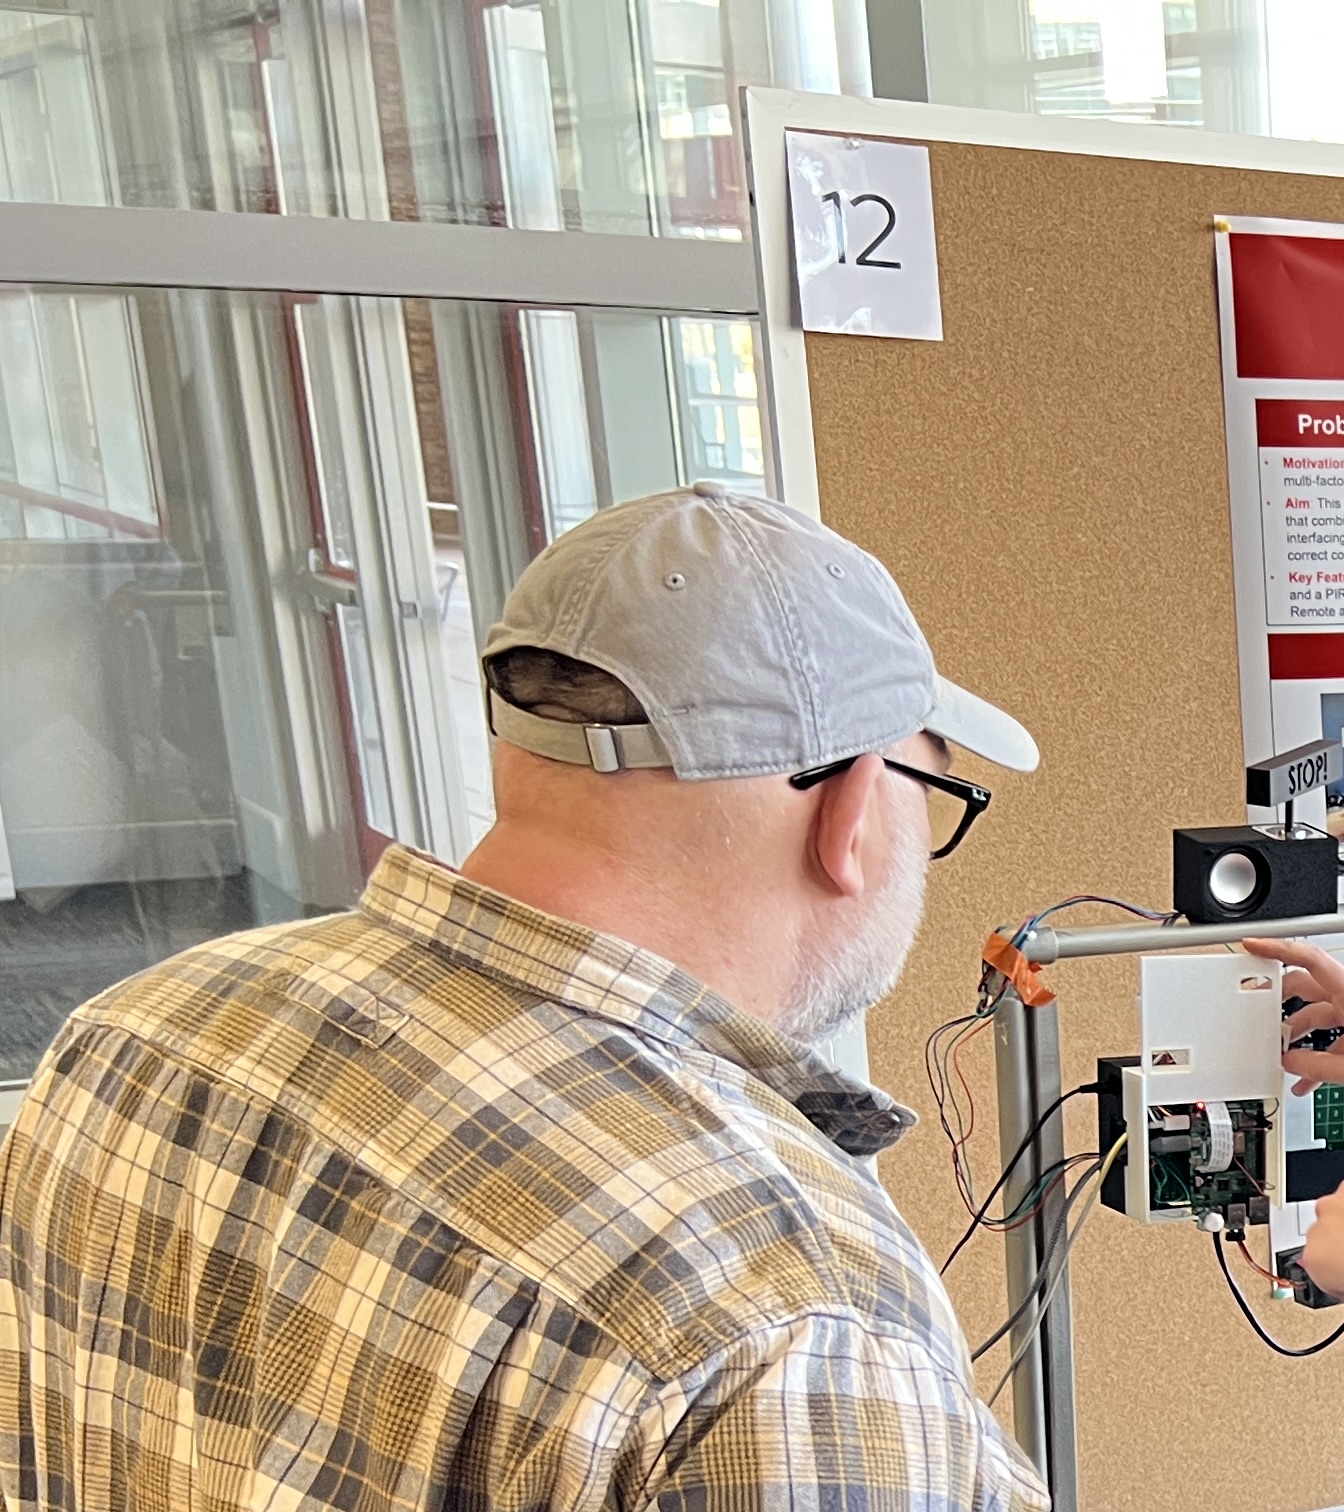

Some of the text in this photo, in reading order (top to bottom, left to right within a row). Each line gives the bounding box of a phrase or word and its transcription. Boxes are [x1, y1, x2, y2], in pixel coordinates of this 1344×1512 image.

[821, 191, 901, 269] 12
[1317, 497, 1341, 509] This
[1285, 515, 1308, 526] that
[1287, 550, 1328, 561] correct
[1288, 571, 1313, 586] Key
[1289, 589, 1312, 600] and
[1314, 591, 1322, 600] a
[1290, 605, 1336, 618] Remote
[1288, 752, 1328, 795] STOP!
